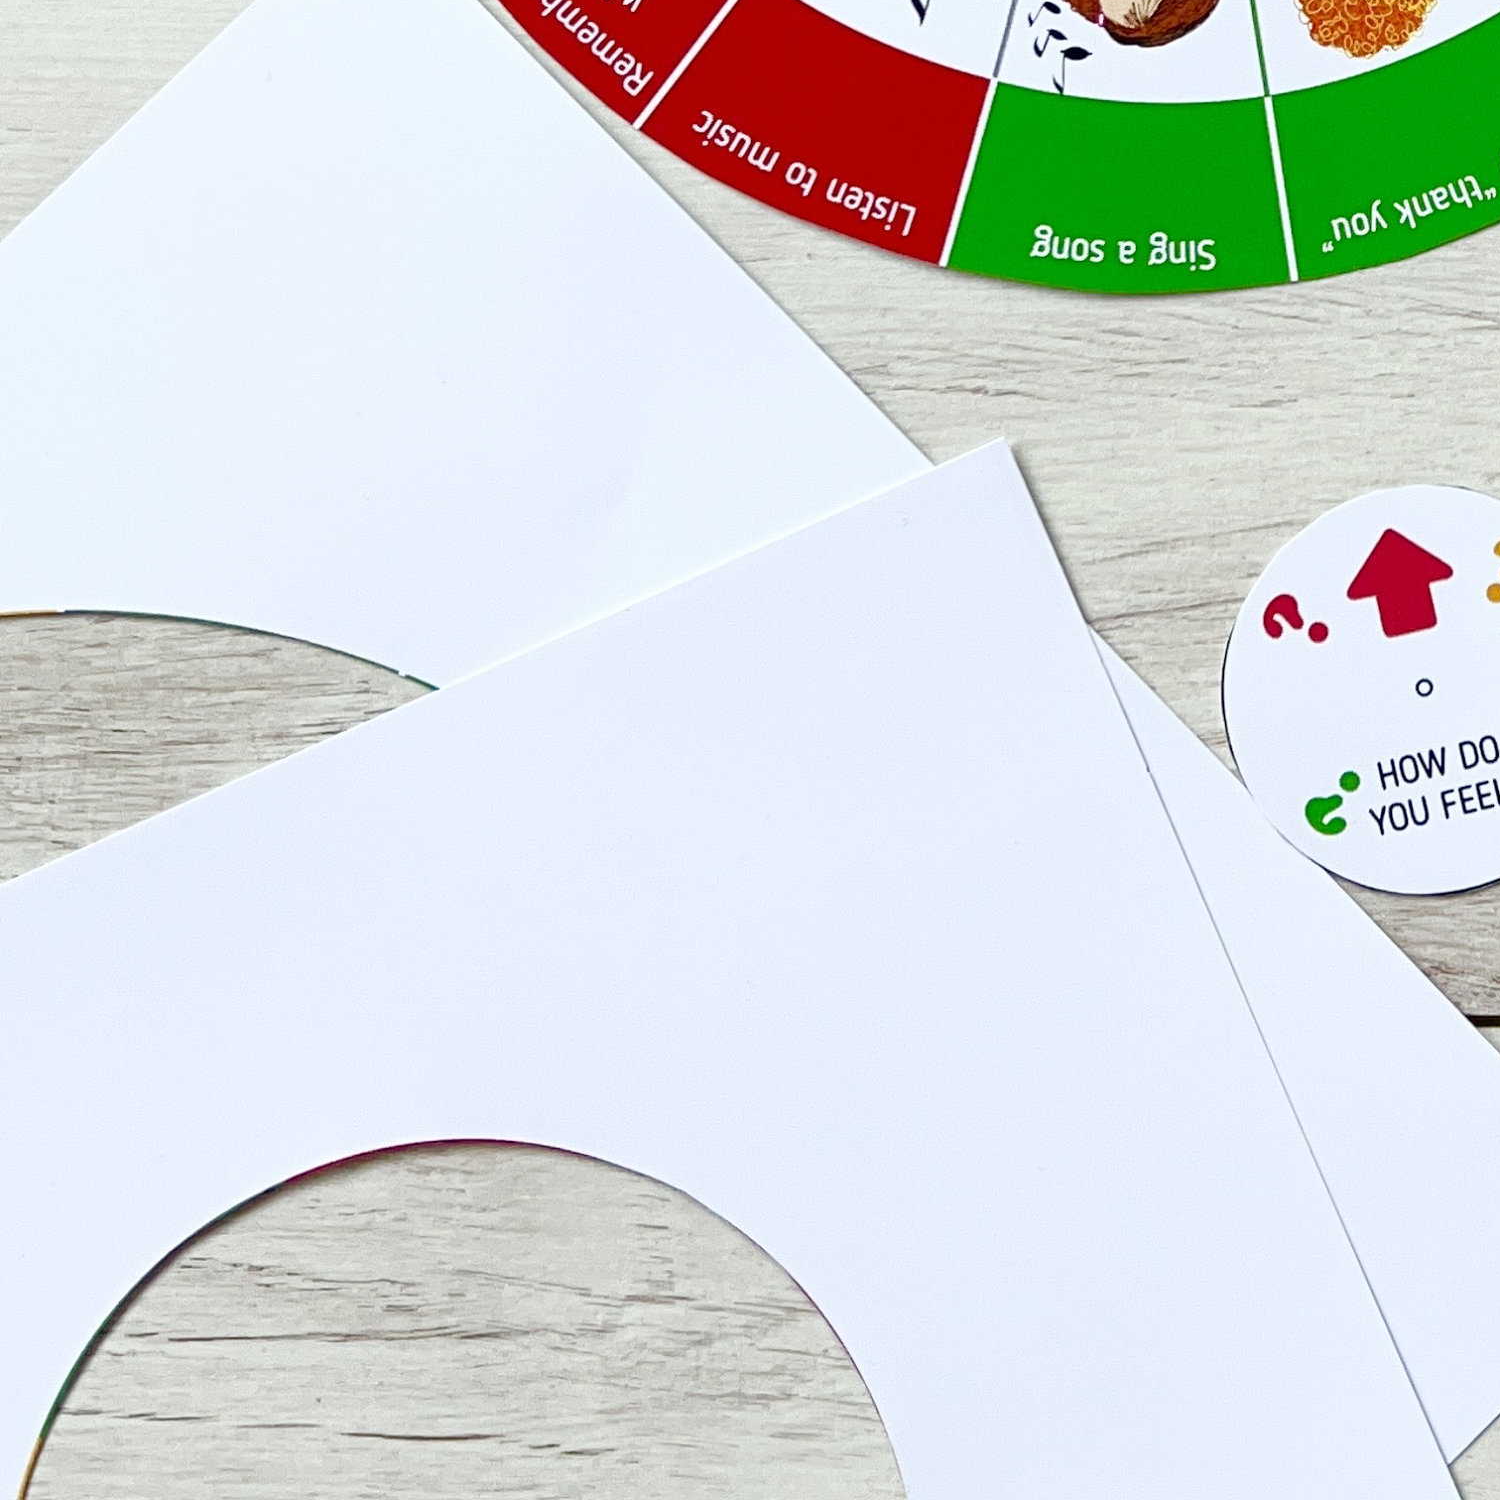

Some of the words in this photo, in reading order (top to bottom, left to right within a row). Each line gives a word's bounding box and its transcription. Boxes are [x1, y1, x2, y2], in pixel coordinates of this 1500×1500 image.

[692, 110, 780, 172] music
[785, 162, 817, 197] to
[826, 178, 917, 236] Listen
[1030, 224, 1106, 263] song
[1117, 240, 1137, 264] a
[1148, 231, 1216, 271] Sing
[1376, 747, 1447, 791] HOW
[1459, 736, 1500, 770] DO
[1368, 796, 1431, 836] YOU
